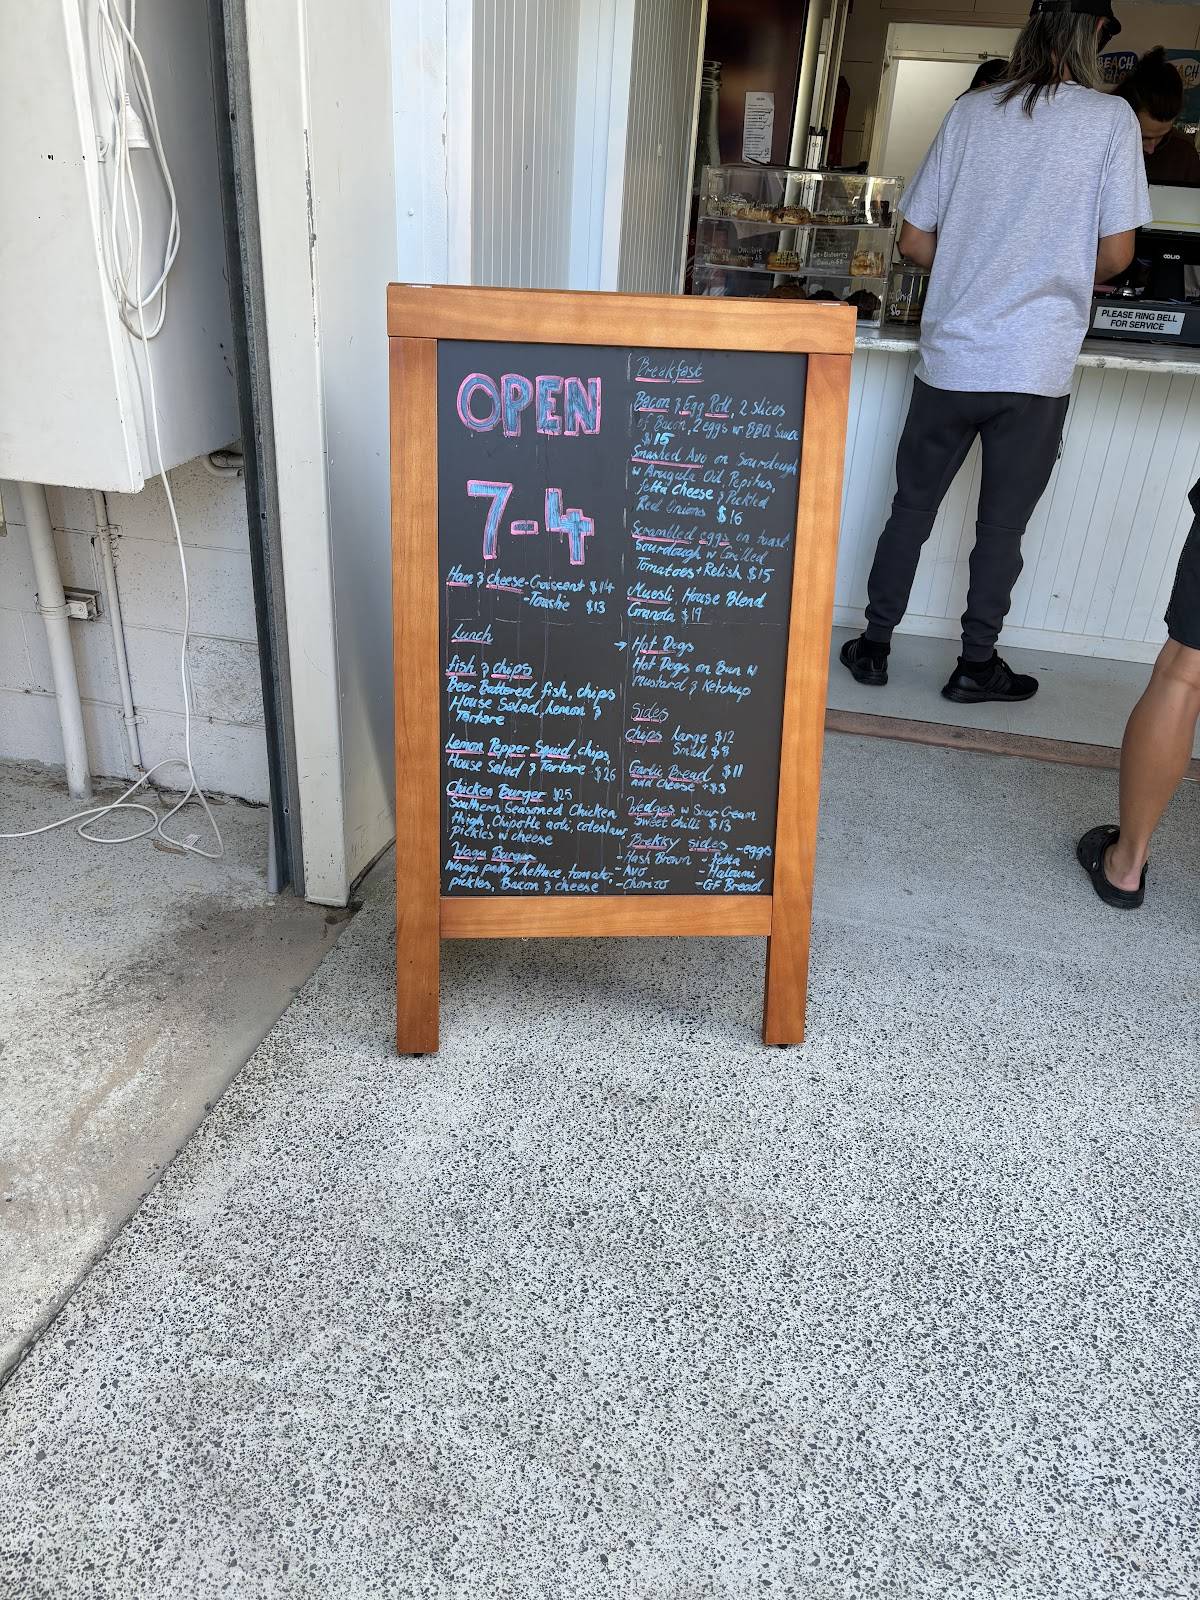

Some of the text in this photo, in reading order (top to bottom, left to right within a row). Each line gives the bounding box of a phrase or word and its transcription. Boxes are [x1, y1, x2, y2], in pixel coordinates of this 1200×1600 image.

[1101, 310, 1178, 322] PLEASE RING BELL
[1129, 321, 1165, 330] SERVICE
[635, 356, 704, 383] Breakfast
[456, 373, 601, 437] OPEN
[633, 391, 672, 413] Bacon
[679, 396, 704, 416] Egg
[740, 400, 747, 417] 2
[702, 421, 729, 440] eggs
[631, 445, 799, 479] Smashed Avo on Sourdough
[635, 495, 661, 512] Red
[665, 500, 706, 518] Onions
[467, 480, 594, 565] 7-4
[631, 520, 698, 543] Scrambled
[699, 530, 730, 548] eggs
[735, 534, 751, 543] on
[635, 540, 702, 563] Sourdough
[719, 546, 768, 565] Grilled
[446, 564, 474, 587] Ham
[702, 562, 743, 580] Relish
[746, 564, 775, 584] $15
[585, 600, 606, 614] $13
[681, 586, 721, 605] House
[725, 590, 768, 608] Blend
[627, 601, 702, 624] Granola $19
[451, 624, 494, 645] Lunch
[631, 634, 695, 656] Hot Dogs
[632, 655, 657, 673] Hot
[695, 663, 711, 674] on
[715, 660, 742, 676] Bun
[447, 676, 476, 692] Beer
[701, 678, 752, 702] Ketchup
[449, 695, 492, 711] House
[631, 702, 669, 722] Sides
[445, 733, 484, 754] Lemon
[488, 737, 530, 759] Pepper
[671, 725, 708, 748] Large
[714, 730, 735, 746] $12
[672, 742, 707, 760] Small
[447, 754, 482, 772] House
[487, 760, 525, 778] Salad
[594, 766, 617, 783] $26
[629, 760, 744, 783] Garlic Bread $11
[446, 778, 493, 799] Chicken
[552, 788, 572, 803] $25
[504, 801, 564, 816] Seasoned
[569, 804, 618, 820] Chicken
[626, 795, 676, 817] Wedges
[692, 804, 719, 818] Sour
[720, 805, 757, 821] Cream
[708, 819, 732, 833] $13
[654, 852, 693, 868] Brown
[500, 876, 541, 891] Bacon
[725, 878, 765, 893] Bread
